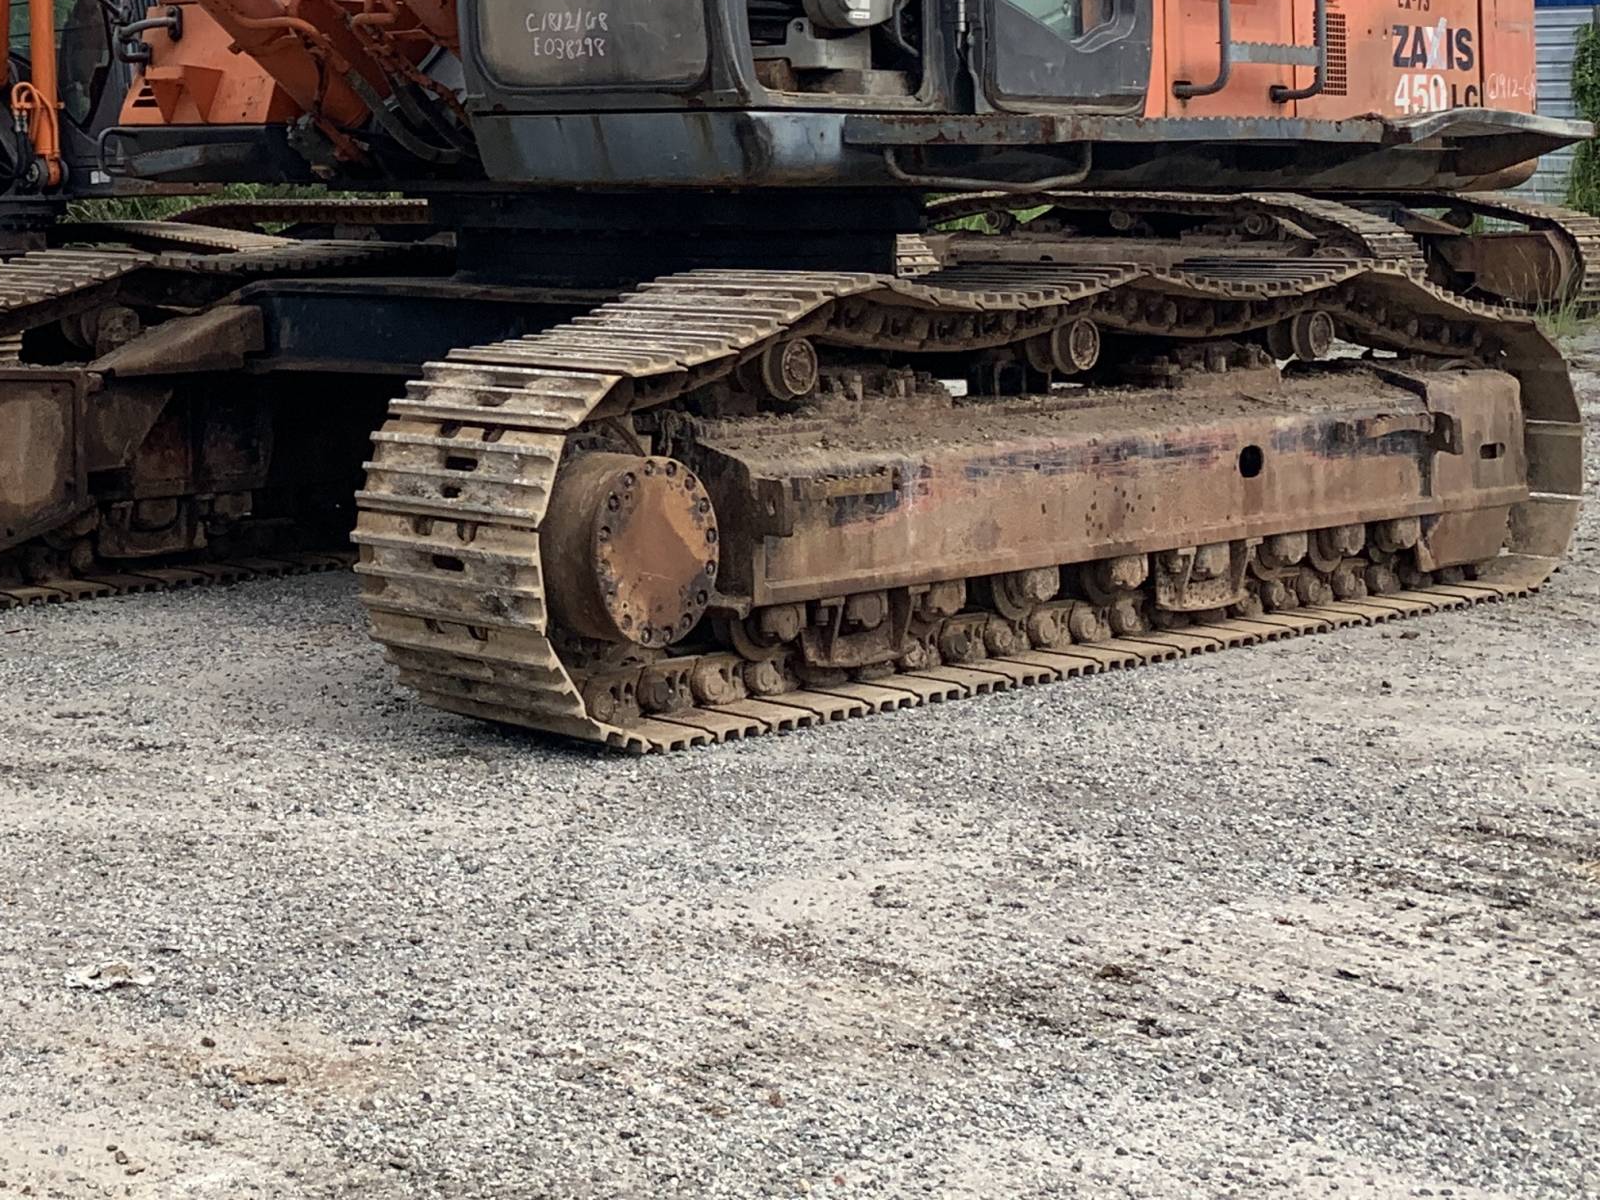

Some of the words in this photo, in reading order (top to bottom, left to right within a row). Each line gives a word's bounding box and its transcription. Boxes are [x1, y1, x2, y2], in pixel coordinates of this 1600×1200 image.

[1392, 17, 1474, 71] ZAXIS
[1394, 73, 1448, 114] 450
[1451, 84, 1478, 108] LC
